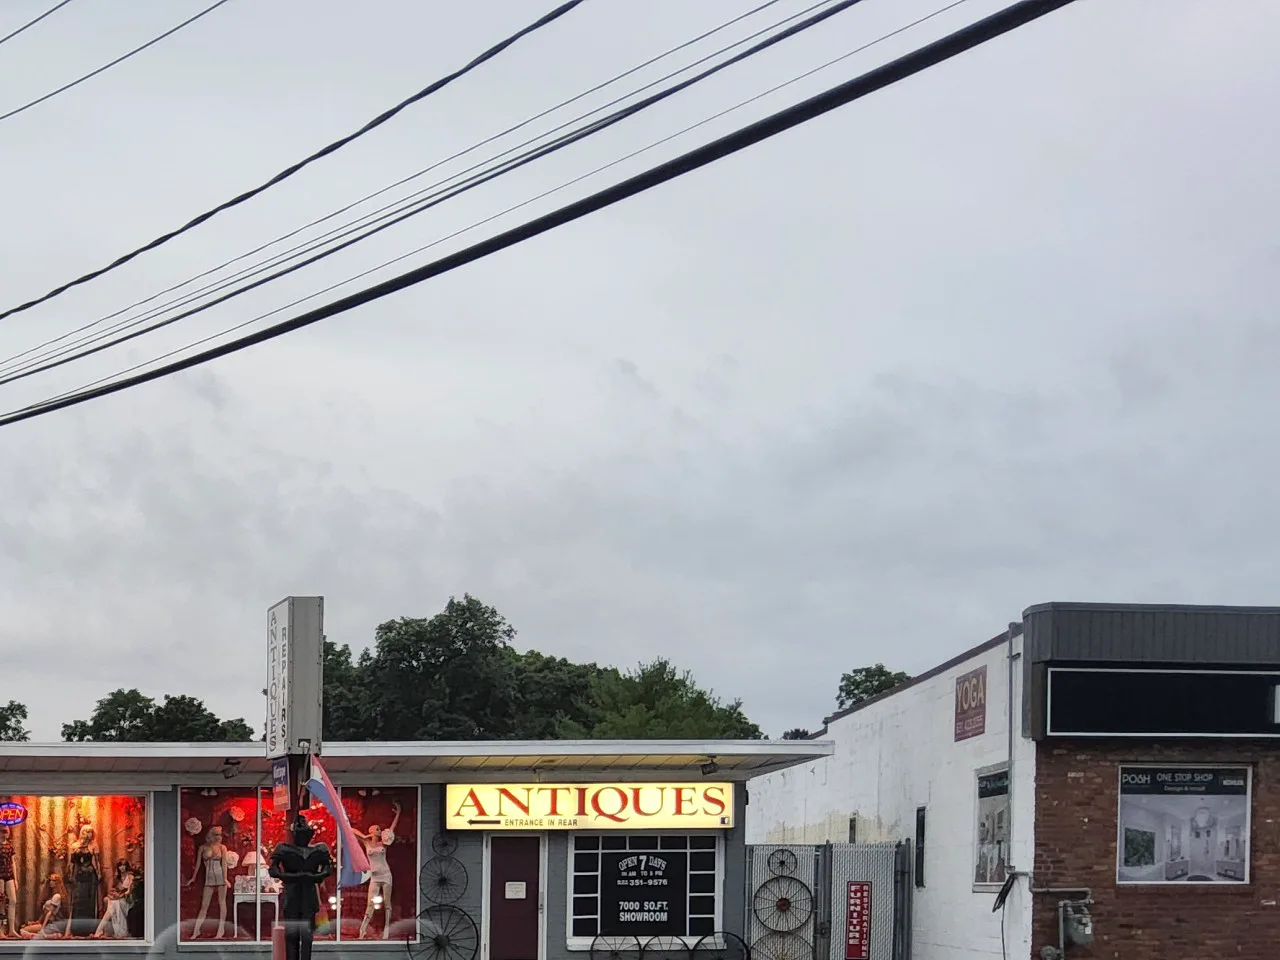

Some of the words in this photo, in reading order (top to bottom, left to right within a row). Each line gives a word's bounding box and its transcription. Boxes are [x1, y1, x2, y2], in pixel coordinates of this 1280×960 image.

[957, 675, 985, 713] YOGA
[1122, 773, 1151, 784] POSH
[1156, 773, 1172, 782] ONE
[1175, 773, 1192, 782] STOP
[1194, 773, 1214, 782] SHOP
[452, 787, 726, 822] ANTIQUES
[504, 819, 544, 827] ENTRANCE
[548, 819, 555, 827] IN
[558, 819, 578, 827] REAR
[618, 855, 638, 871] OPEN
[639, 855, 647, 871] 7
[648, 855, 667, 871] DAYS
[619, 901, 640, 911] 7000
[619, 911, 668, 922] SHOWROOM
[849, 885, 861, 944] FURNITURE
[861, 885, 869, 957] RESTORATIONS
